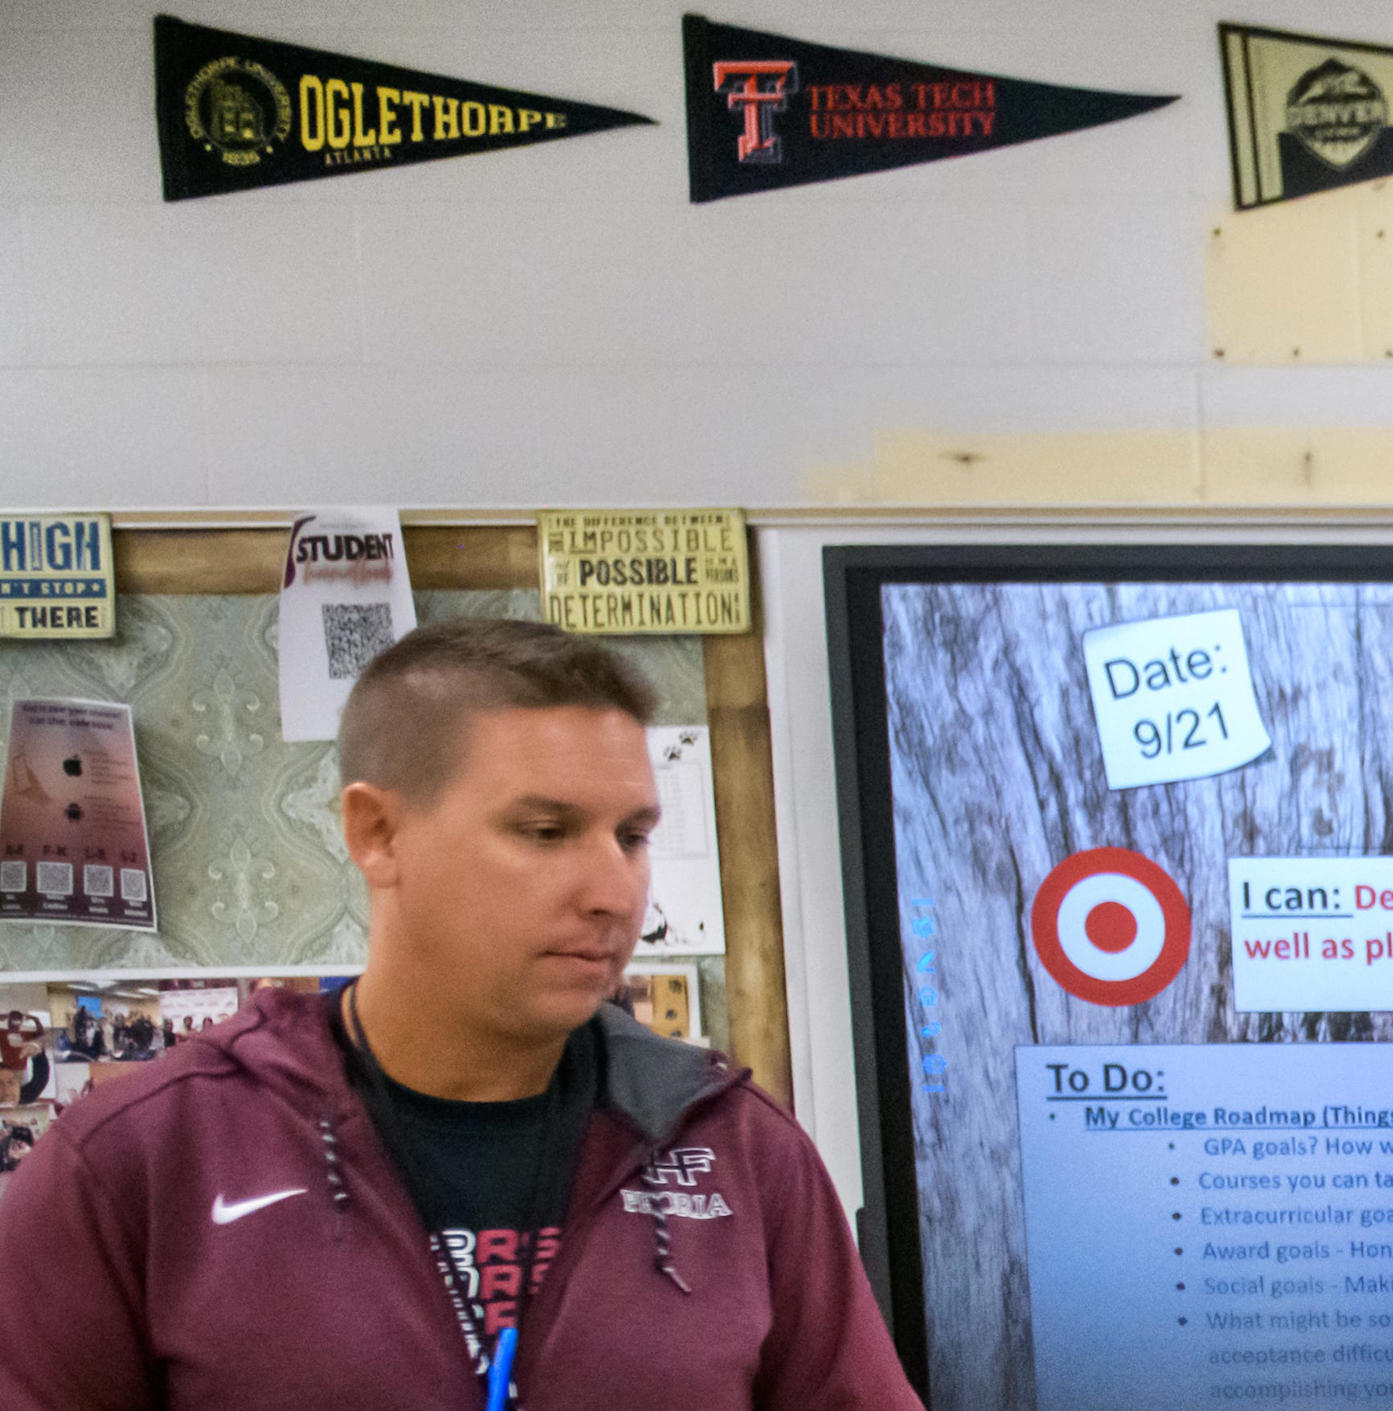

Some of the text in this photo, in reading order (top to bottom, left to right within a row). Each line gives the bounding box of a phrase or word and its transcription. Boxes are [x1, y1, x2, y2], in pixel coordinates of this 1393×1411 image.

[806, 79, 994, 111] TEXAS TECH
[299, 74, 568, 152] OGLETHORPE
[810, 110, 995, 138] UNIVERSITY
[324, 146, 391, 166] ATLANTA
[1, 521, 100, 571] HIGH
[296, 533, 393, 563] STUDENT
[570, 528, 735, 553] IMPOSSIBLE
[579, 558, 698, 586] POSSIBLE
[41, 582, 86, 596] STOP
[15, 605, 99, 628] THERE
[550, 592, 733, 629] DETERMINATION
[1103, 645, 1230, 703] Date:
[1133, 703, 1232, 760] 9/21
[1243, 882, 1251, 910] I
[1264, 885, 1341, 911] can:
[1244, 932, 1310, 959] well
[1322, 938, 1355, 958] as
[1046, 1064, 1165, 1093] To Do:
[1085, 1108, 1118, 1128] My
[1129, 1108, 1206, 1129] College
[1214, 1107, 1315, 1128] Roadmap
[1204, 1138, 1246, 1156] GPA
[1253, 1136, 1318, 1160] goals?
[1325, 1137, 1373, 1156] How
[1200, 1172, 1280, 1190] Courses
[1289, 1174, 1325, 1193] you
[1332, 1174, 1368, 1188] can
[1200, 1205, 1353, 1227] Extracurricular
[1202, 1242, 1269, 1261] Award
[1276, 1241, 1329, 1264] goals
